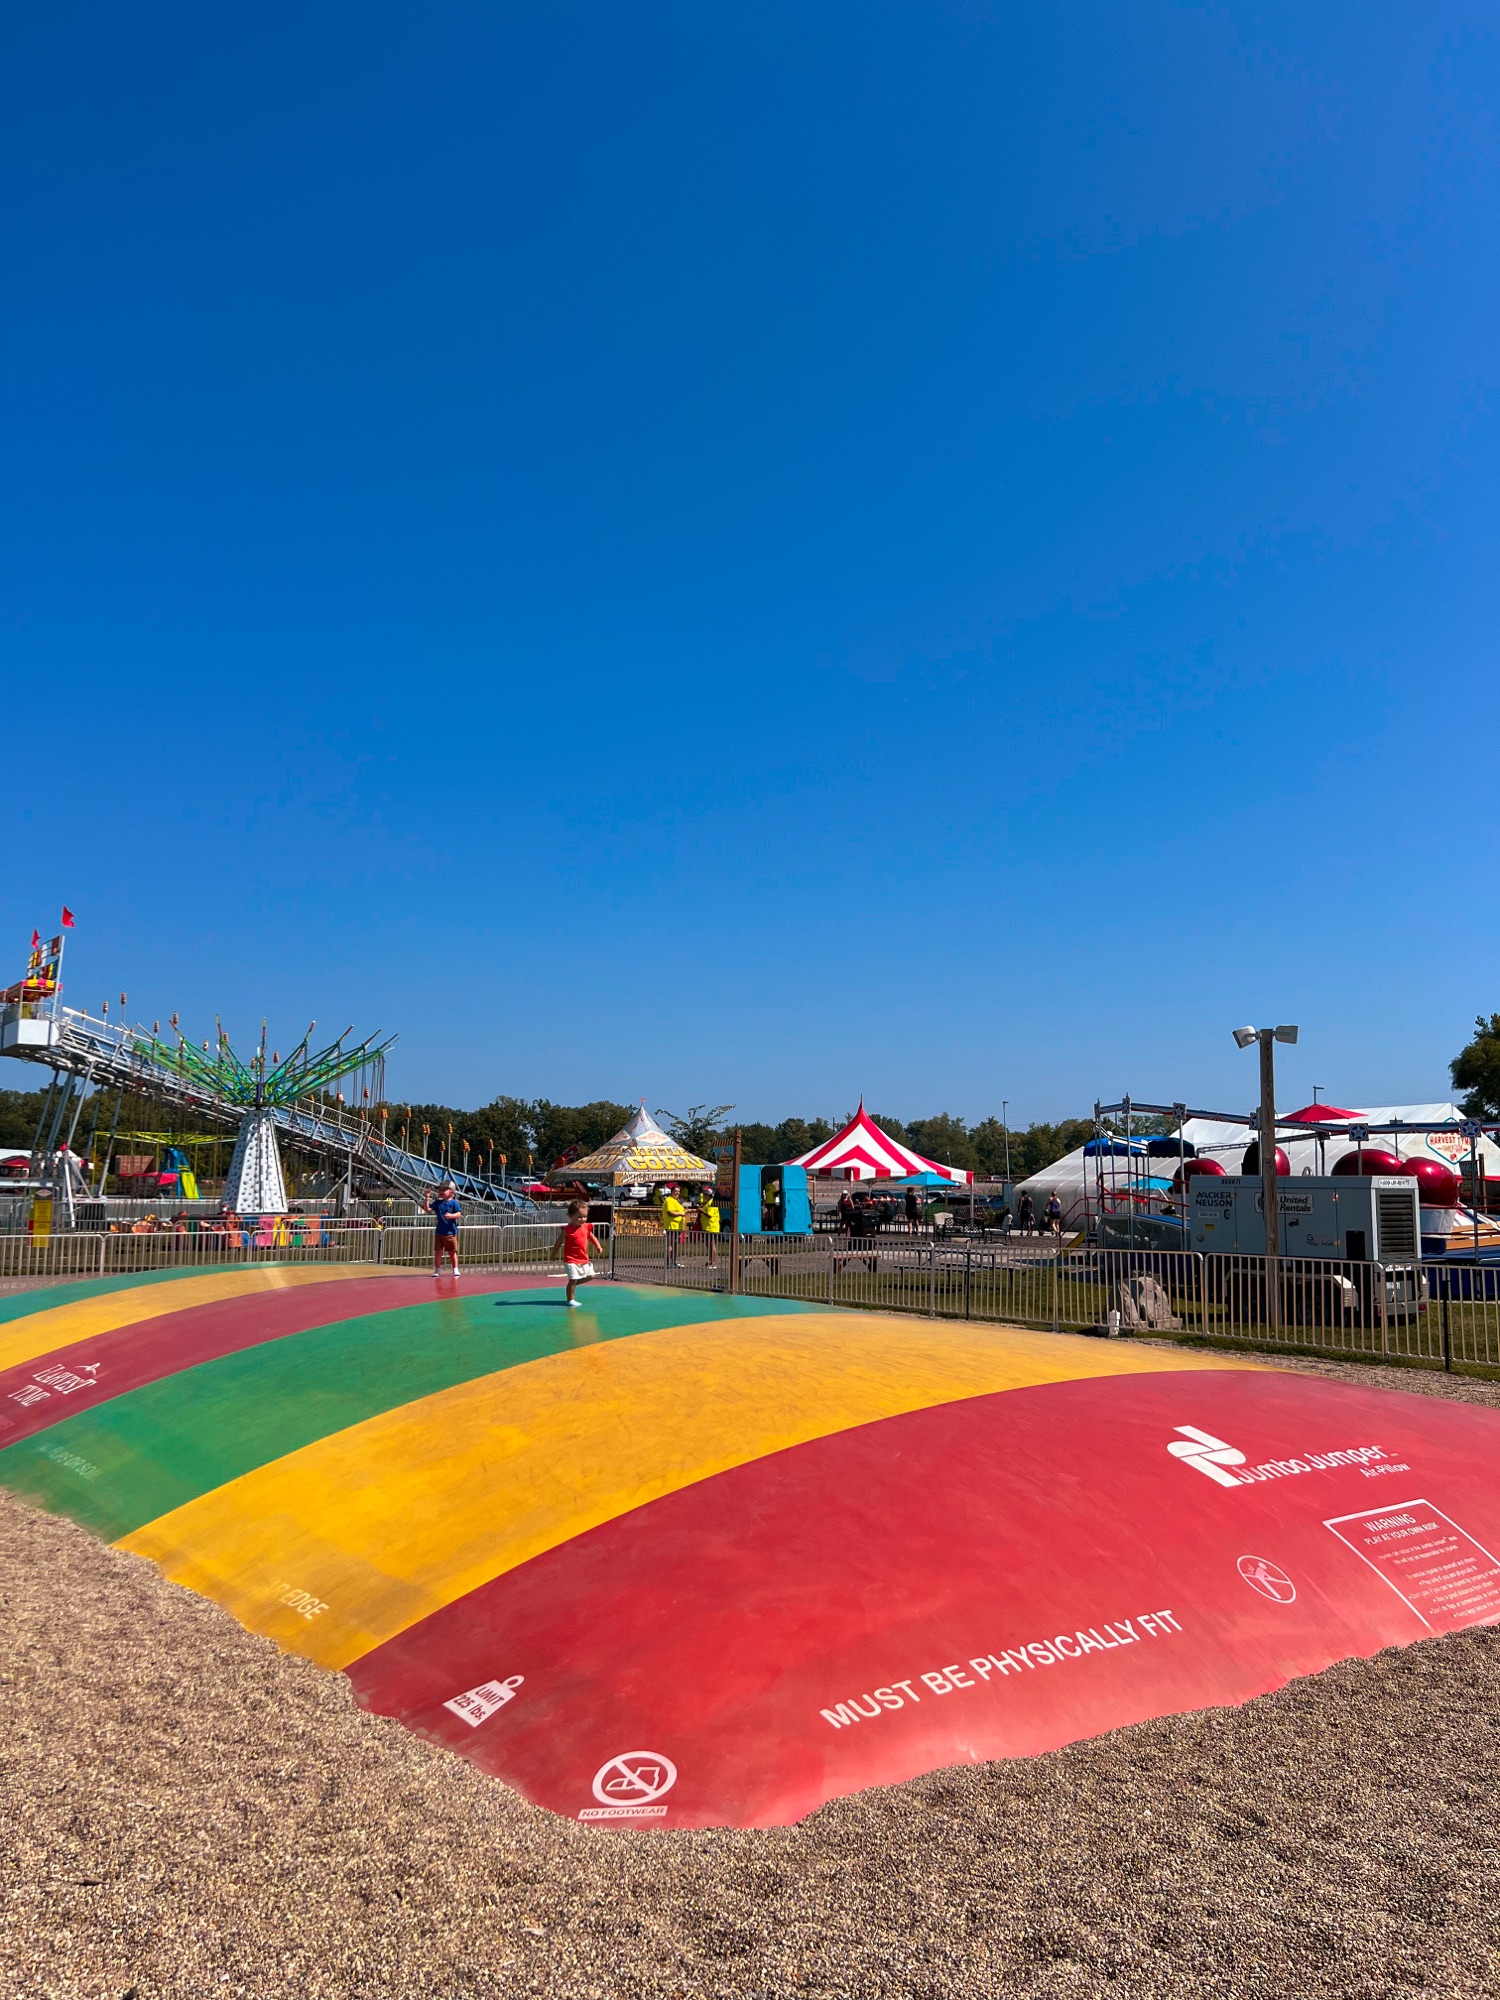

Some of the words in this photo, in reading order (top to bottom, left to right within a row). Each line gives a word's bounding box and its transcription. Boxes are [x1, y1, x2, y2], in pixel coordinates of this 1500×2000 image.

[633, 1146, 688, 1156] KETTLE
[626, 1155, 706, 1170] CORN
[1195, 1199, 1232, 1207] NEUSON
[1280, 1196, 1308, 1204] United
[1280, 1203, 1311, 1212] Rentals
[1363, 1513, 1416, 1532] WARNING
[1363, 1535, 1383, 1544] PLAY
[1388, 1529, 1409, 1539] YOUR
[1406, 1525, 1425, 1534] OWN
[1421, 1521, 1440, 1530] RISK
[278, 1588, 330, 1620] EDGE
[819, 1679, 920, 1729] MUST
[920, 1664, 975, 1695] BE
[969, 1618, 1141, 1680] PHYSICALLY
[1136, 1609, 1183, 1638] FIT
[475, 1686, 505, 1705] LIMIT
[453, 1694, 475, 1709] 225
[467, 1703, 486, 1720] lbs.
[601, 1807, 664, 1817] FOOTWEAR
